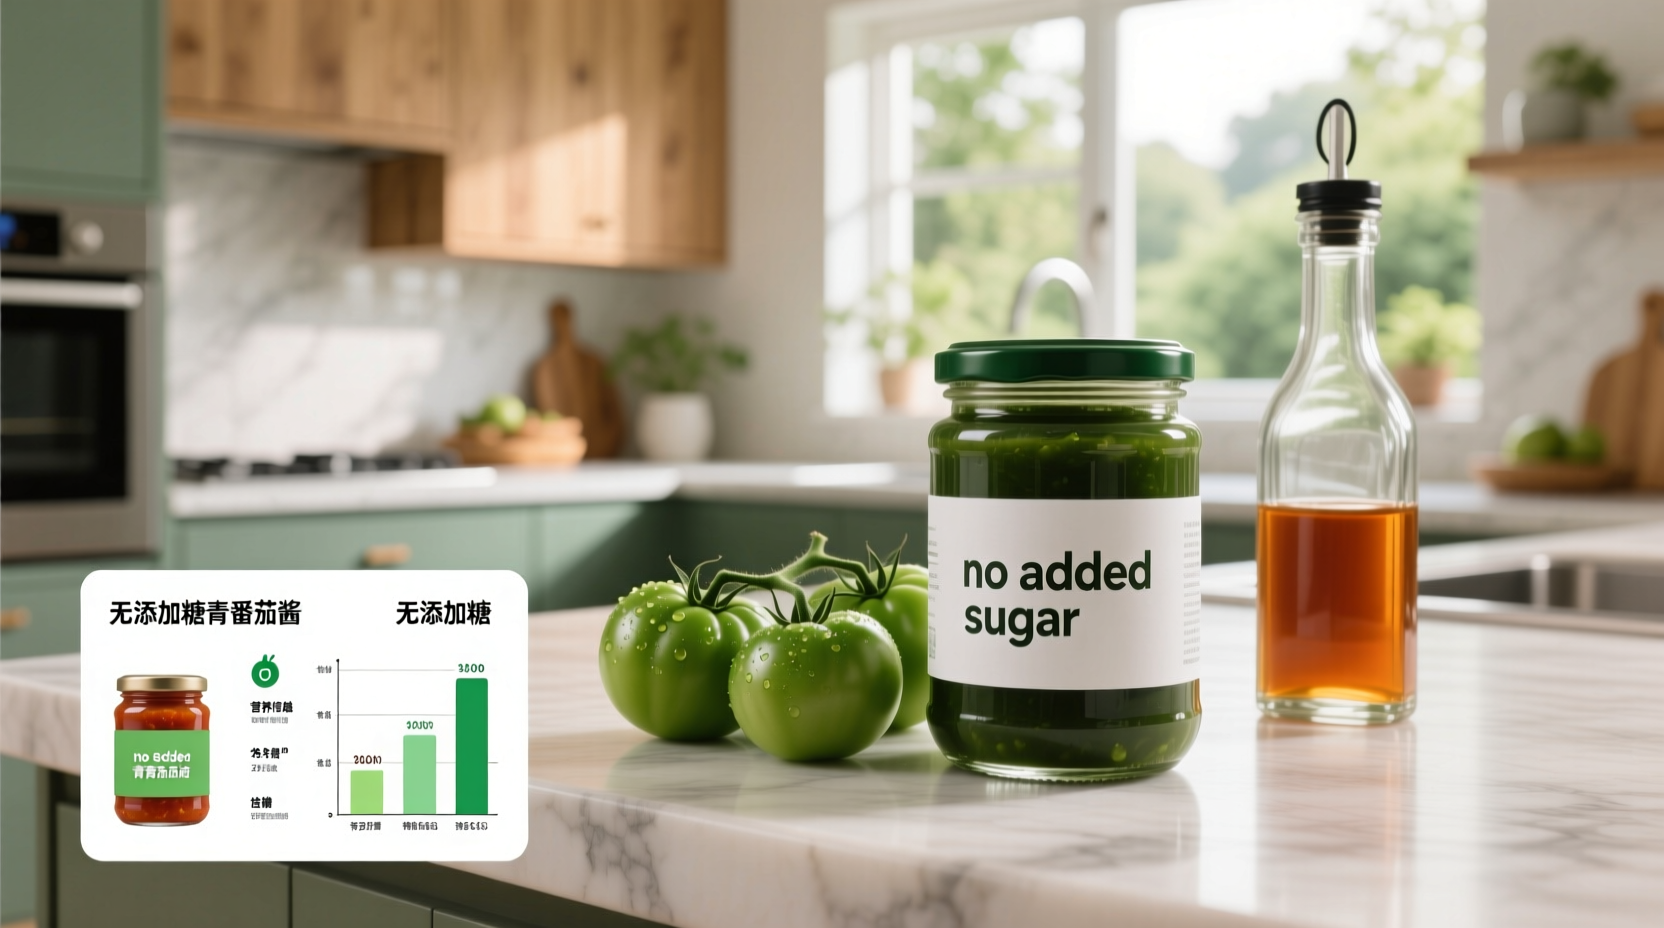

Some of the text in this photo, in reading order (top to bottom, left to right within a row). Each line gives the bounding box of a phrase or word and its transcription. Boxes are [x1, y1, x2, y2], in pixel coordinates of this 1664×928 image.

[963, 549, 1152, 591] no added
[964, 604, 1081, 648] sugar
